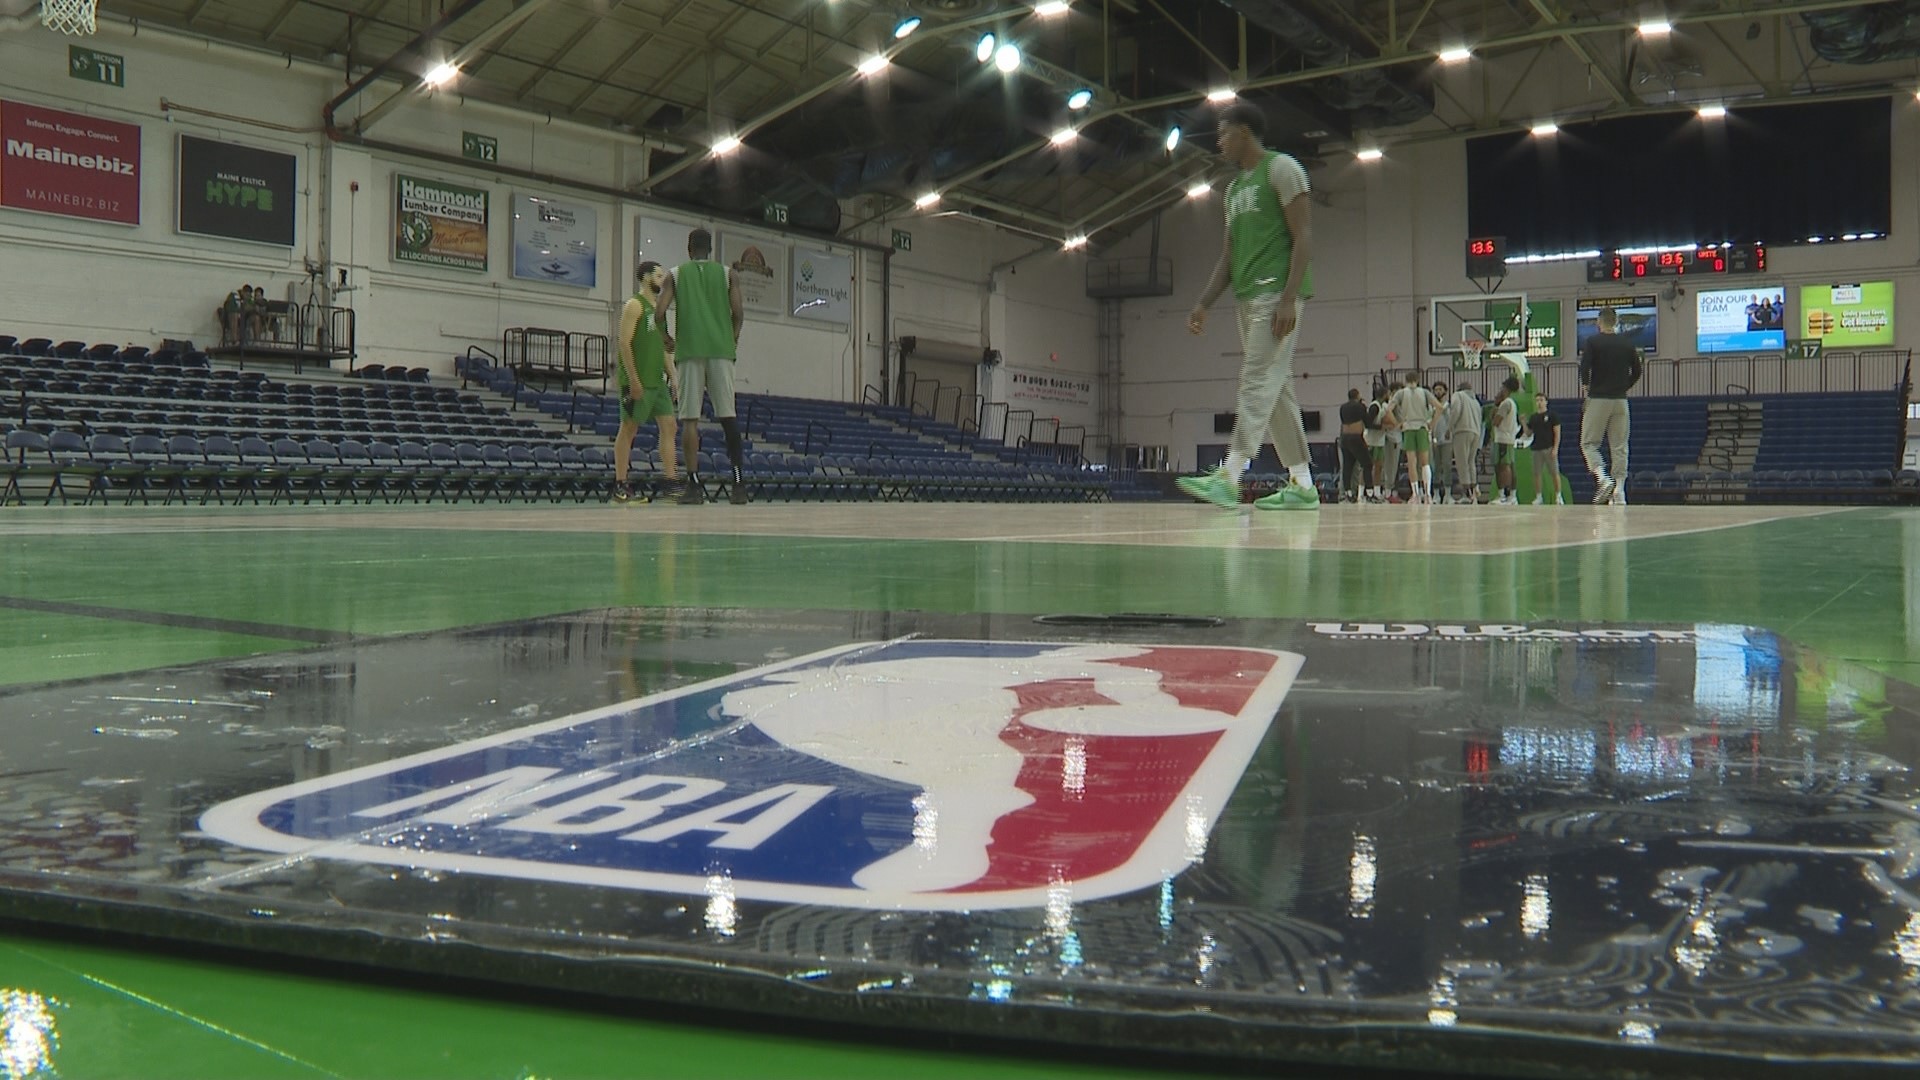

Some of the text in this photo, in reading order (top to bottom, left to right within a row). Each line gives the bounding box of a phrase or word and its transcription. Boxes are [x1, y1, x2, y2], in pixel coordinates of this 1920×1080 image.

[98, 63, 116, 83] 11
[26, 119, 119, 142] Inform. Engage. Connect.
[7, 139, 134, 175] Mainebiz
[479, 144, 494, 160] 12
[217, 172, 266, 187] MAINE CELTICS
[26, 189, 119, 212] MAINEBIZ.BIZ
[207, 181, 272, 211] HYPE
[402, 180, 484, 208] Hammond
[405, 199, 482, 222] Lumber Company
[776, 209, 787, 223] 13
[900, 237, 910, 250] 14
[409, 252, 441, 263] LOCATIONS
[443, 257, 465, 267] ACROSS
[1637, 264, 1644, 275] 0
[1714, 259, 1723, 270] 0
[796, 281, 848, 301] Northern Light
[1701, 294, 1748, 305] JOIN OUR
[1701, 304, 1728, 313] TEAM
[1527, 327, 1556, 338] ELTICS
[1803, 346, 1819, 358] 17
[349, 766, 837, 850] NBA
